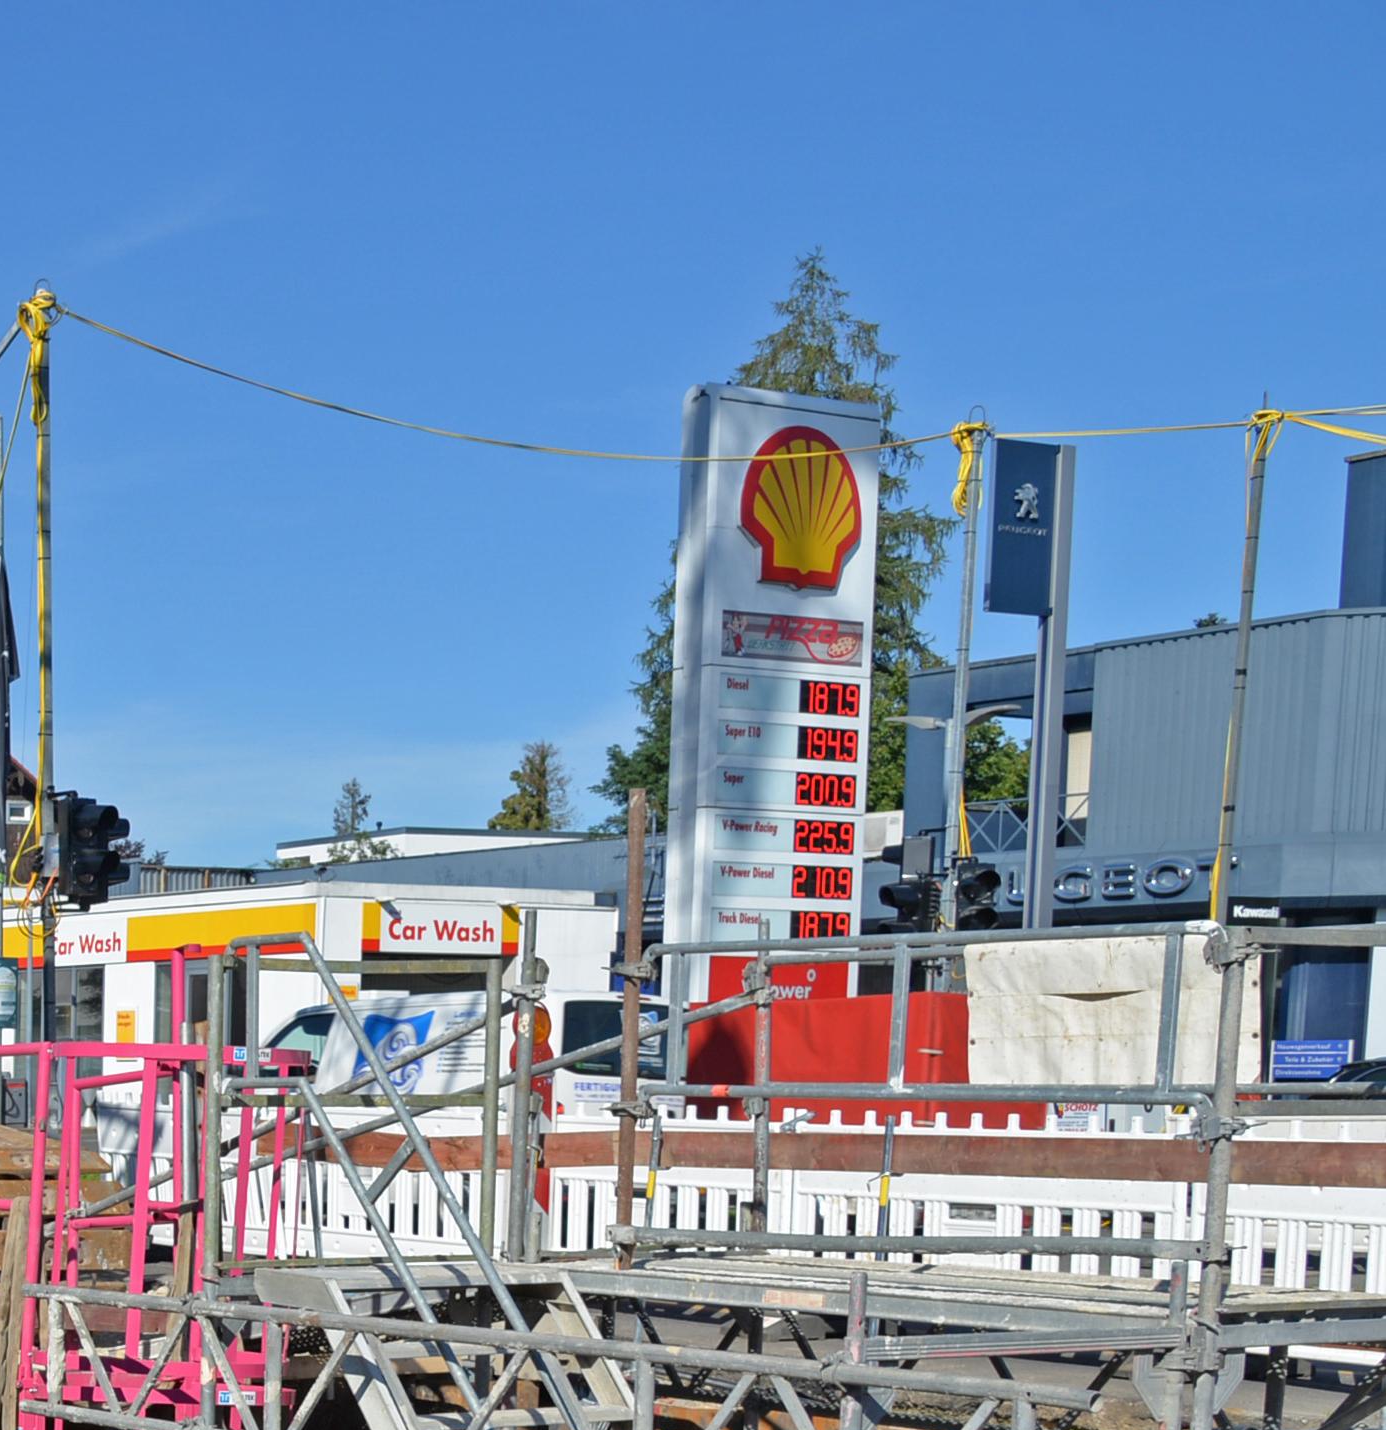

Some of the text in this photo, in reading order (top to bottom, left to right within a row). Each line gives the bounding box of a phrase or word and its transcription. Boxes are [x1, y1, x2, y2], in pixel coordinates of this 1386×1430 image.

[997, 523, 1049, 537] PEUGEOT
[726, 677, 860, 717] Diesel 187.9
[725, 724, 858, 762] Super E10 194.9
[723, 771, 856, 808] Super 200.9
[722, 819, 854, 854] V-Power Racing 225.9
[720, 866, 750, 878] V-Power
[752, 867, 775, 879] Diesel
[388, 917, 495, 942] Car Wash
[718, 912, 737, 924] Truck
[53, 931, 121, 955] ar Wash
